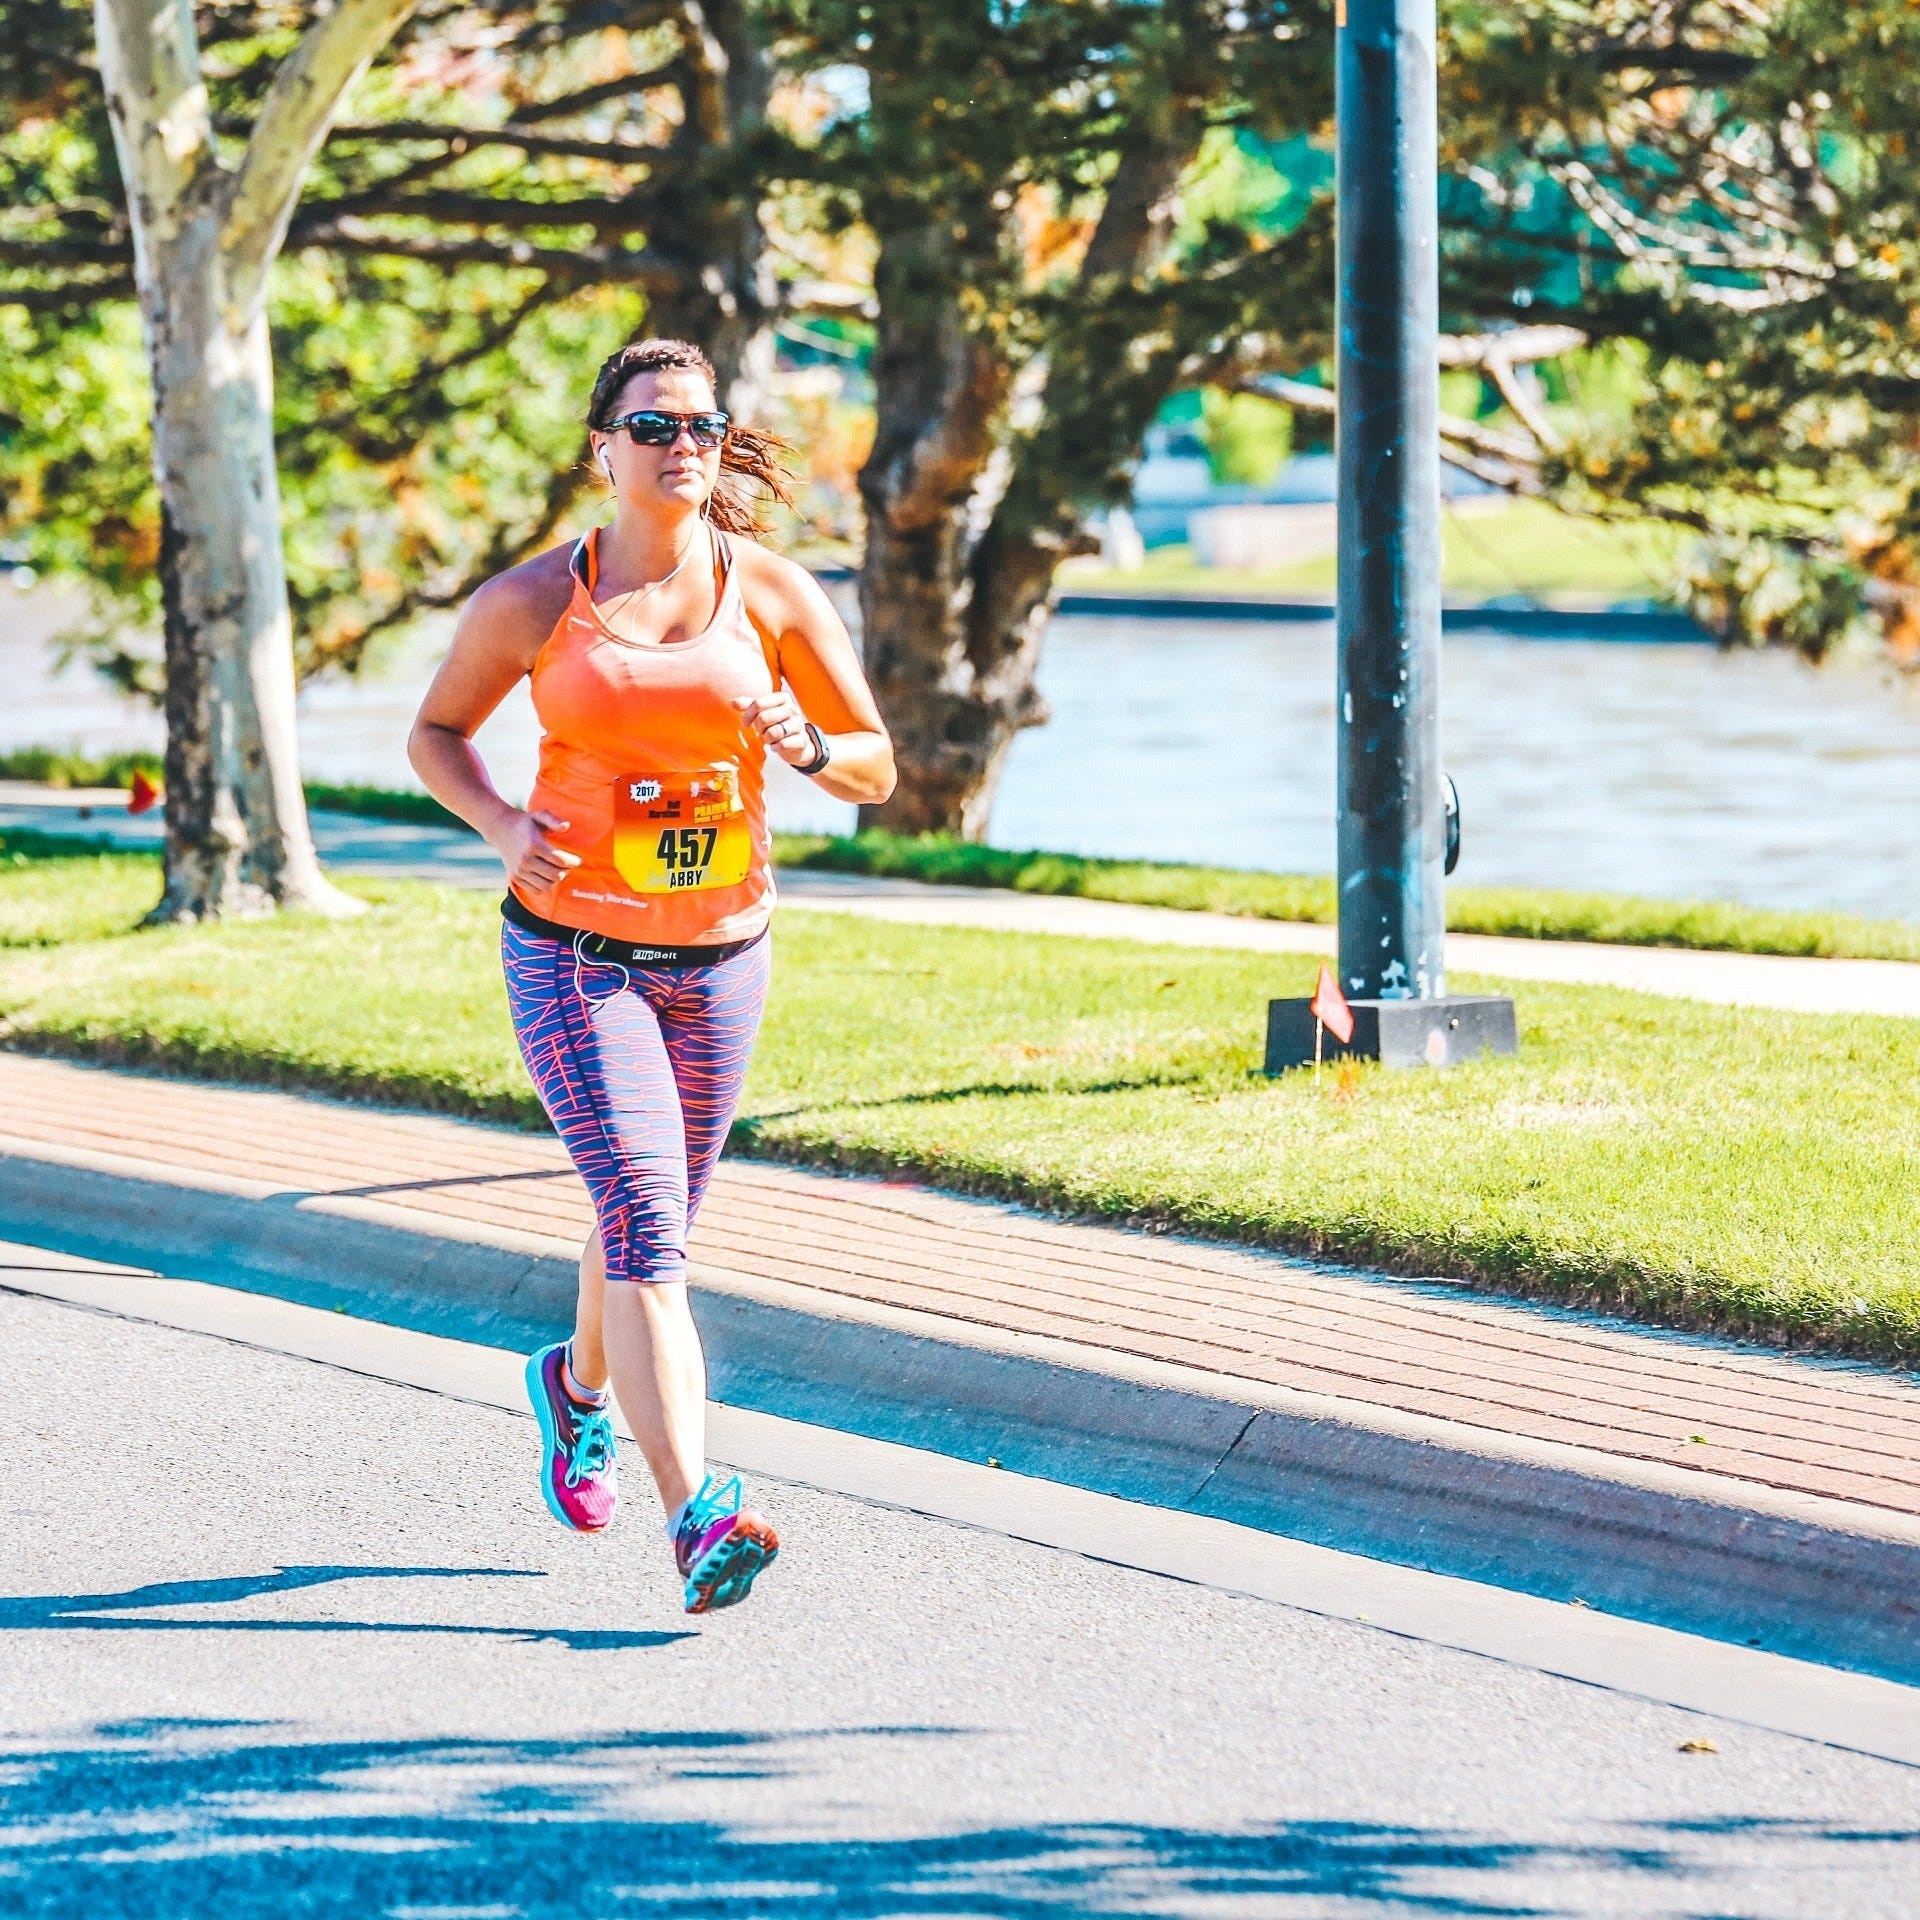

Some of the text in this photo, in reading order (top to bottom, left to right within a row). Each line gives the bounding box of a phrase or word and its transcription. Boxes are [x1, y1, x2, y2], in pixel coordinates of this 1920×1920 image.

[636, 786, 655, 797] 2017
[657, 828, 717, 869] 457
[670, 870, 702, 888] ABBY
